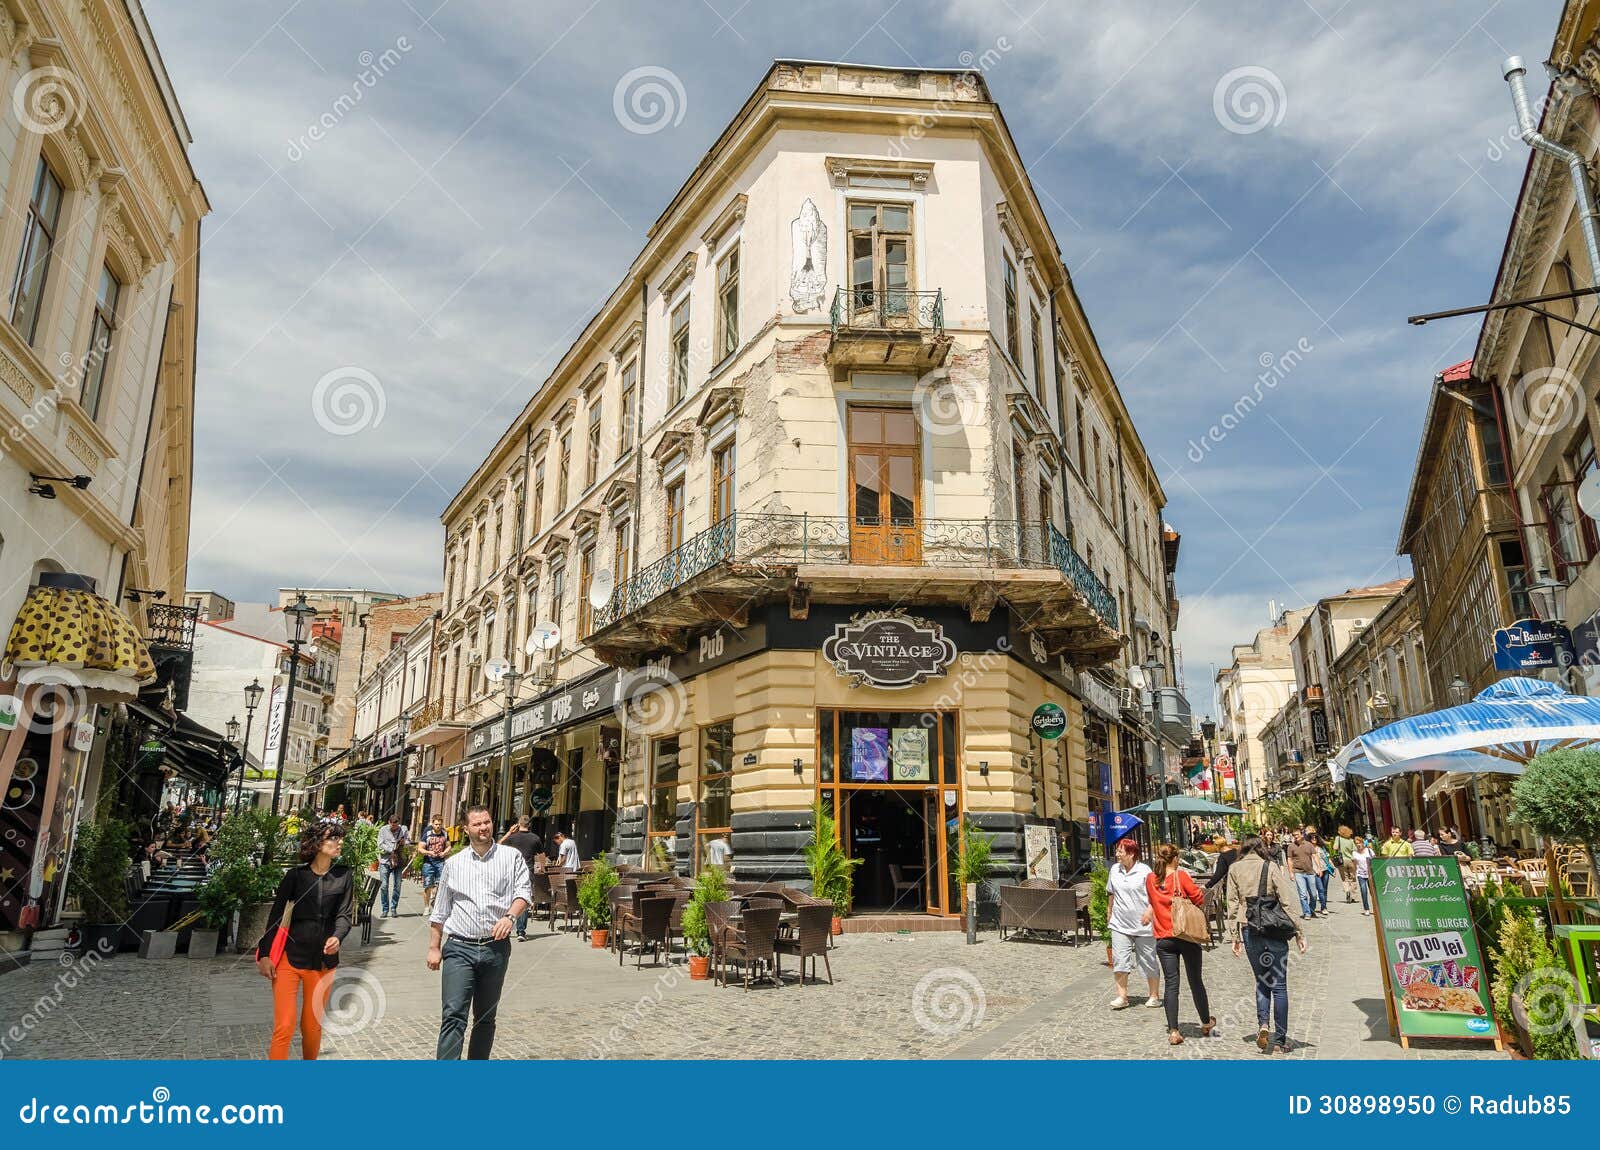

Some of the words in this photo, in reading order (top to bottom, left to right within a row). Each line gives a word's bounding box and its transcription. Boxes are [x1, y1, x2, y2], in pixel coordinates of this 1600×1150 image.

[880, 635, 900, 643] THE
[850, 642, 932, 660] VINTAGE
[1033, 714, 1064, 728] Carlsberg
[1386, 864, 1448, 878] OFERTA
[1416, 918, 1432, 928] THE
[1437, 917, 1470, 928] BURGER
[1442, 937, 1464, 957] lei
